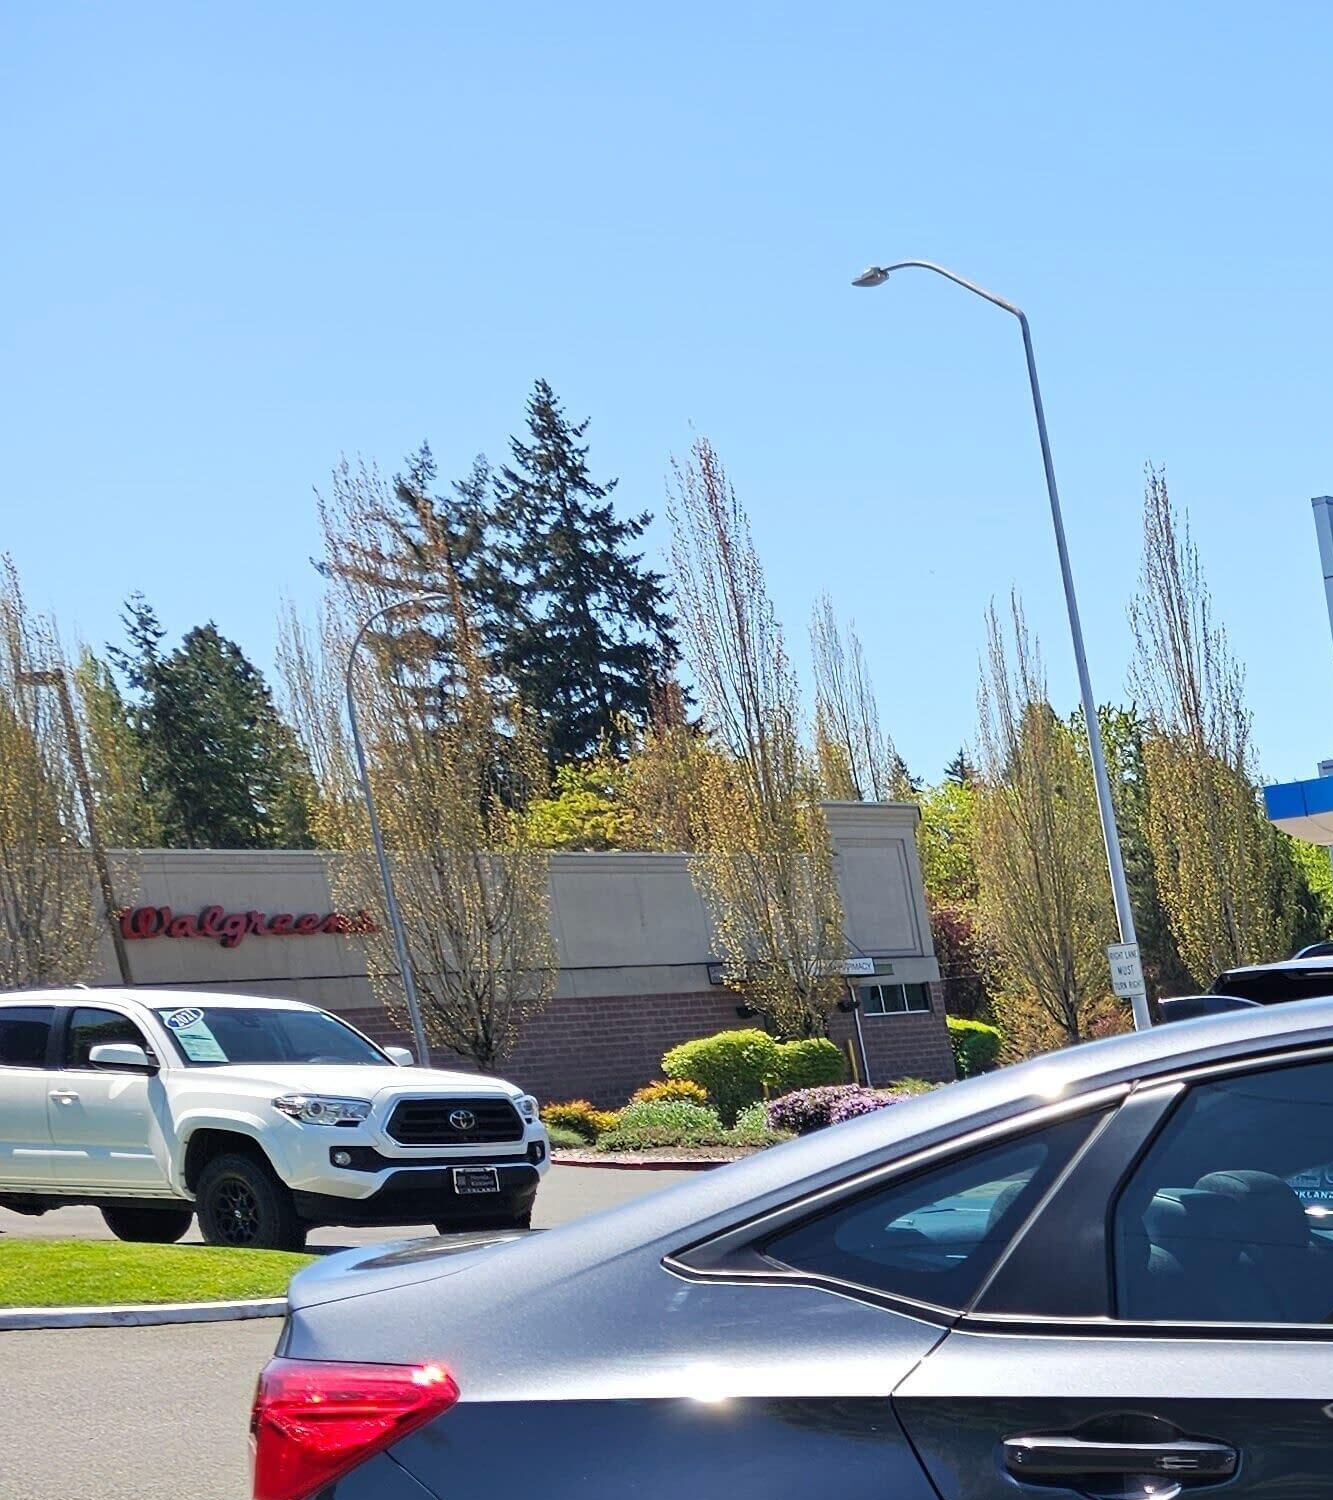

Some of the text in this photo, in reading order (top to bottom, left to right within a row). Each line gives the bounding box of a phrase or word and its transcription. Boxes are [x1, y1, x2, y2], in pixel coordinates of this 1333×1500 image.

[120, 905, 379, 948] Walgreens
[1117, 964, 1134, 976] MUST
[171, 1009, 199, 1027] 2021
